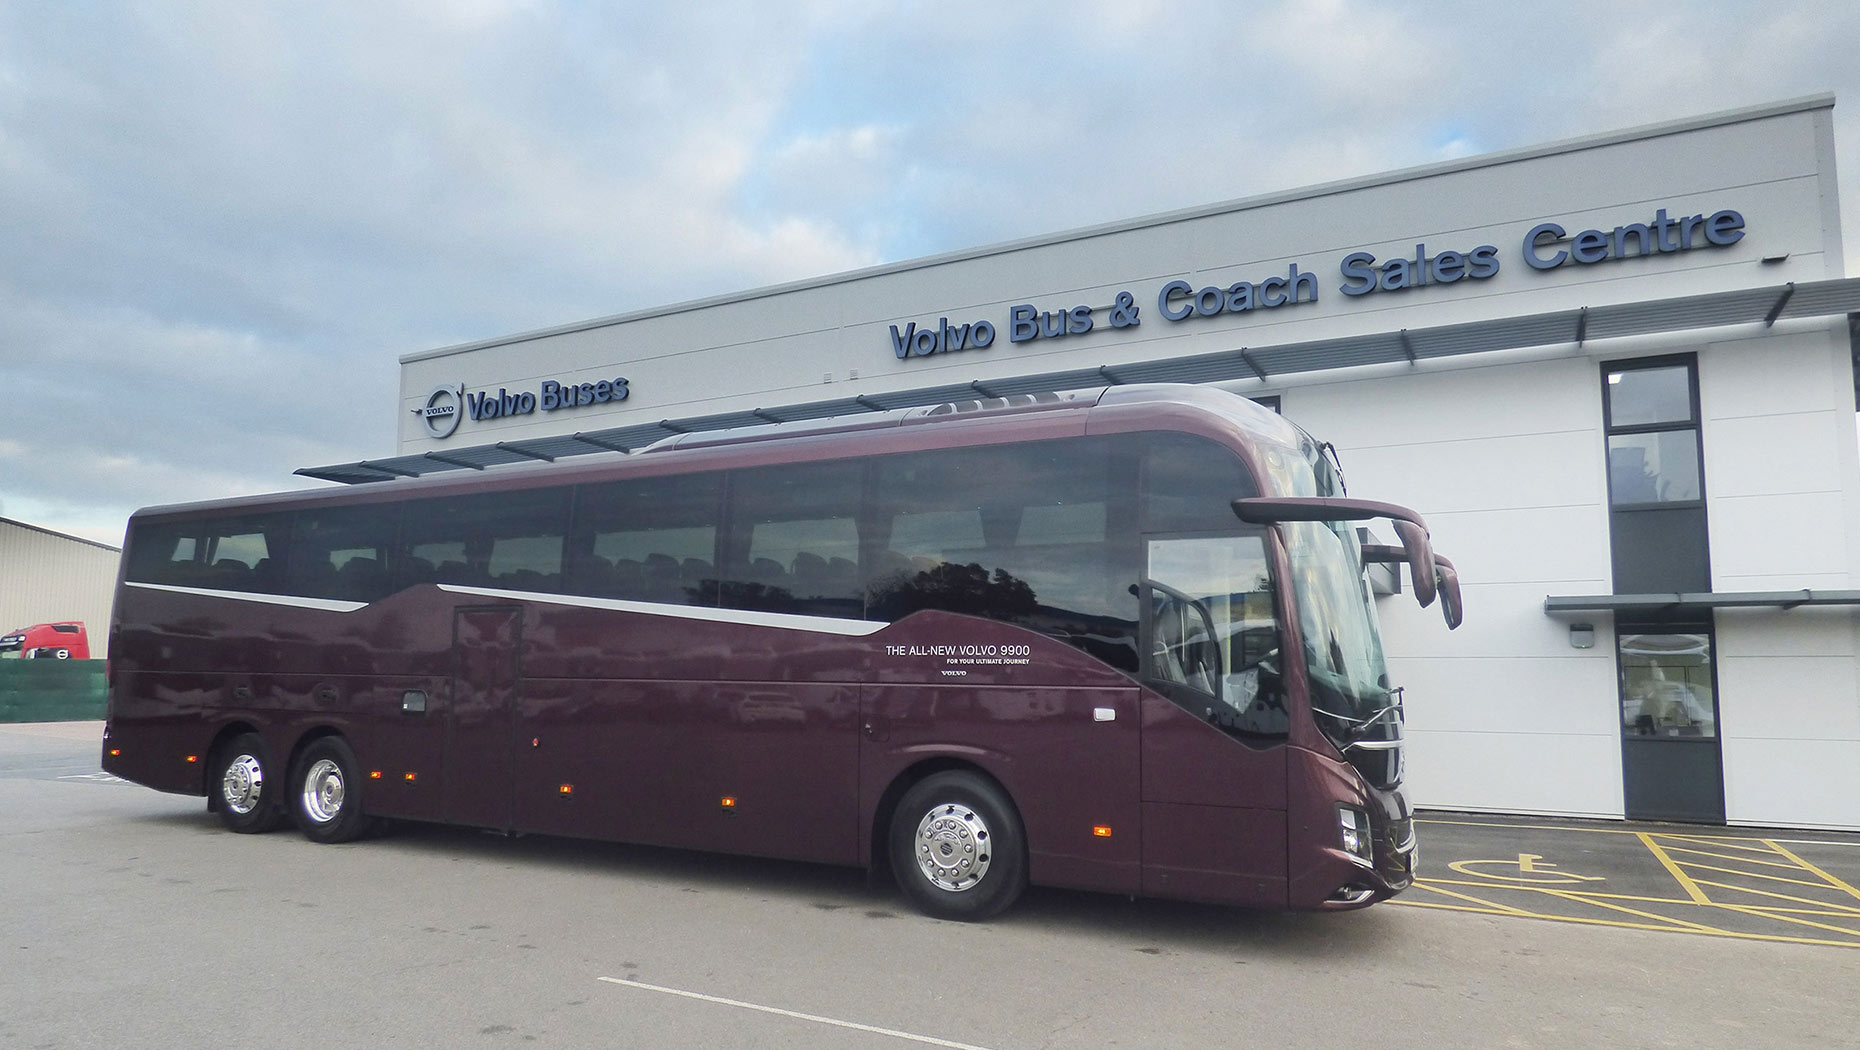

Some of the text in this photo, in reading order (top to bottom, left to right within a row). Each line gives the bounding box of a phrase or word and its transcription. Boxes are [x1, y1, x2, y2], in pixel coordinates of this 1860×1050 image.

[889, 208, 1747, 360] Volvo Bus & Coach Sales Centre
[426, 406, 454, 416] VOLVO
[467, 376, 630, 421] Volvo Buses
[886, 645, 1030, 656] THE ALL-NEW VOLVO 9900
